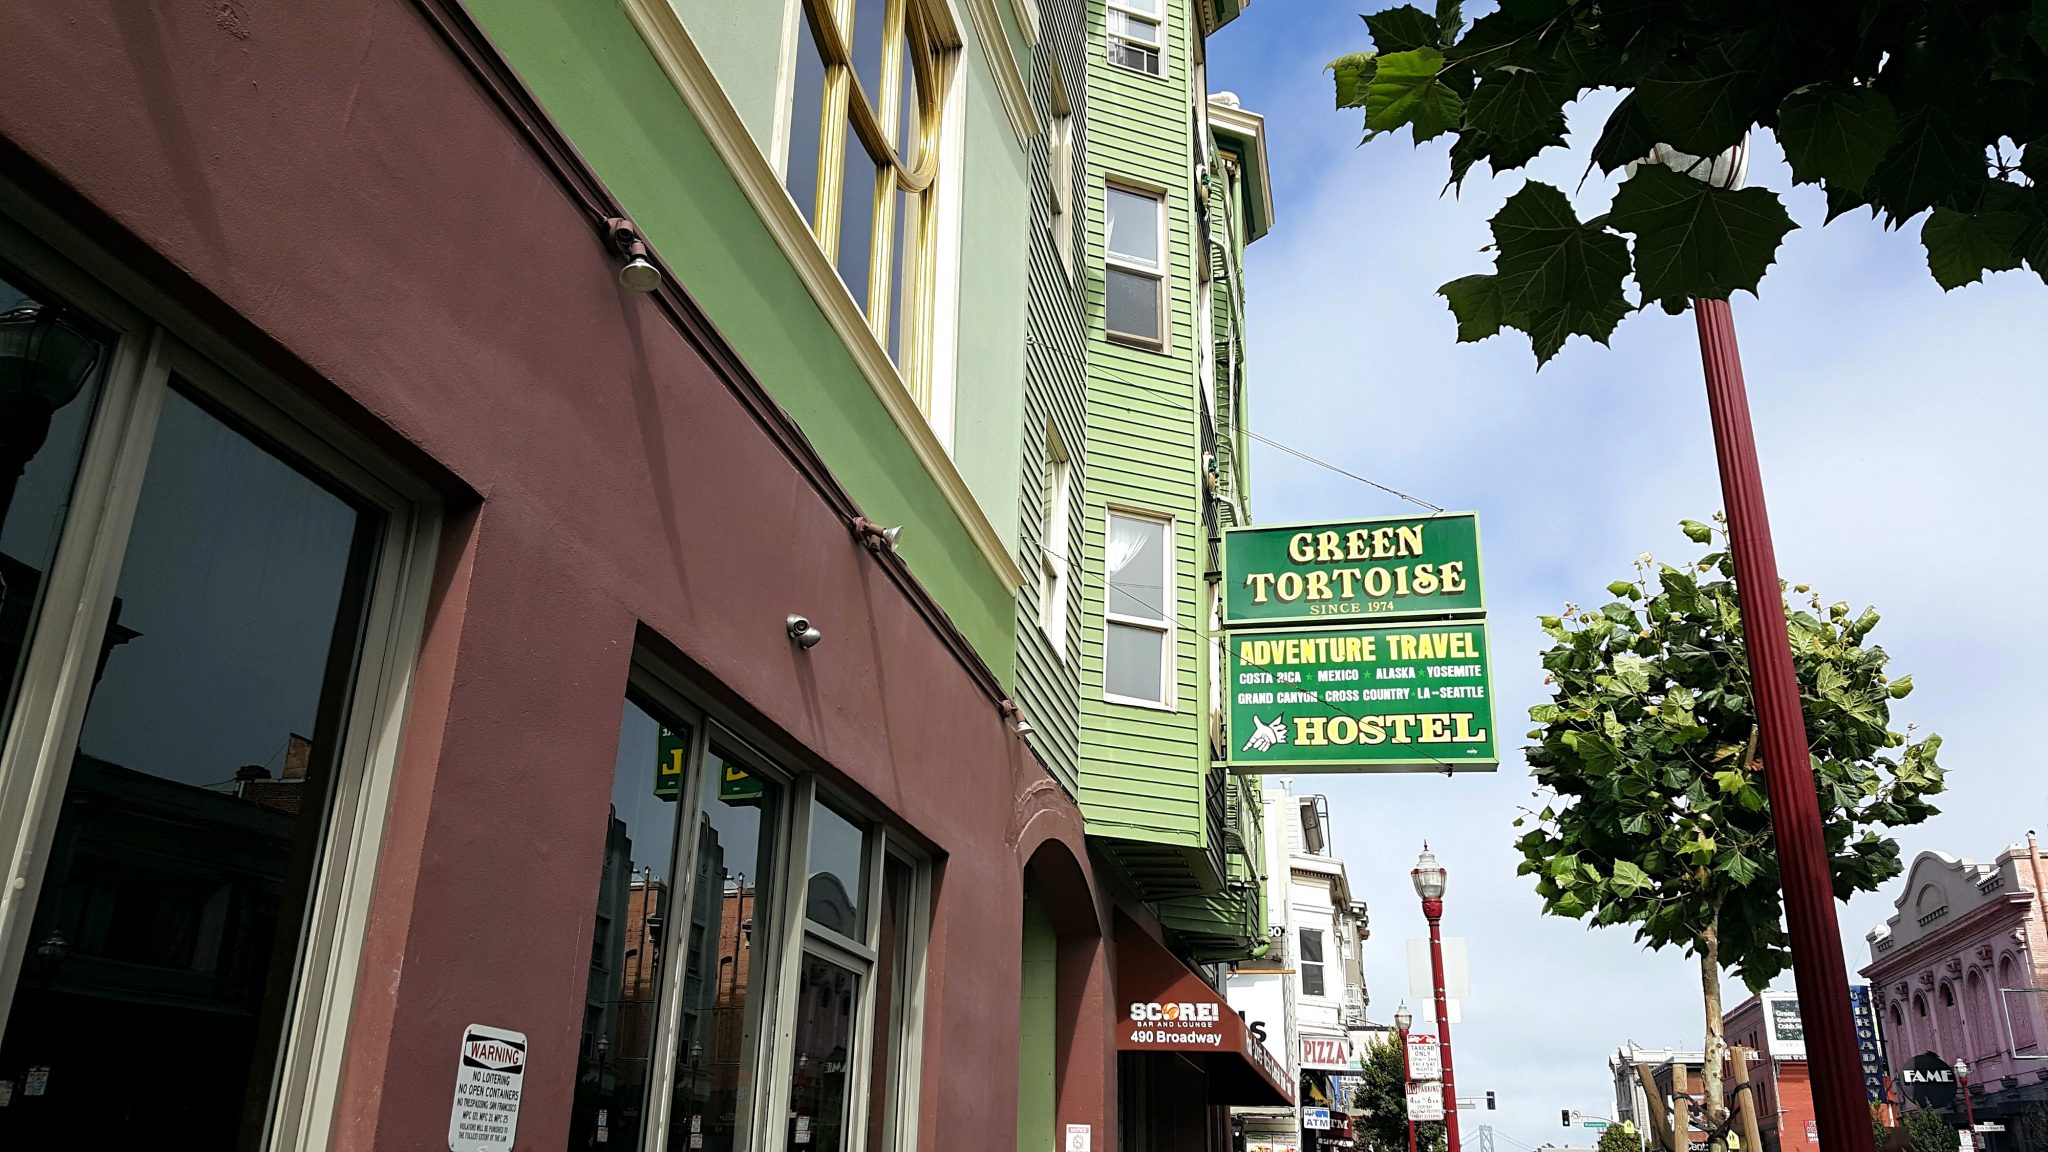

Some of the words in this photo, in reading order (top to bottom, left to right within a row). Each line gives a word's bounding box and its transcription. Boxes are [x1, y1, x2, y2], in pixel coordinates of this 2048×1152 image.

[1288, 524, 1423, 563] GREEN
[1246, 560, 1466, 602] TORTOISE
[1310, 603, 1360, 615] SINCE
[1368, 602, 1394, 612] 1974
[1240, 636, 1376, 666] ADVENTURE
[1386, 632, 1479, 660] TRAVEL
[1239, 672, 1273, 684] COSTA
[1277, 671, 1301, 683] RICA
[1317, 669, 1359, 682] MEXICO
[1376, 667, 1415, 679] ALASKA
[1427, 665, 1482, 678] YOSEMITE
[1238, 692, 1273, 704] GRAND
[1277, 691, 1318, 703] CANYON
[1325, 690, 1359, 702] CROSS
[1363, 688, 1410, 700] COUNTRY
[1293, 712, 1486, 746] HOSTEL
[1130, 1002, 1219, 1021] SCORE!
[1130, 1031, 1153, 1043] 490
[1156, 1031, 1222, 1046] Broadway
[471, 1041, 520, 1065] WARNING
[1303, 1040, 1347, 1065] PIZZA
[1854, 1006, 1881, 1099] BROADWAY
[473, 1070, 481, 1082] NO
[482, 1072, 511, 1086] LOITERING
[1903, 1070, 1954, 1083] FAME
[458, 1083, 468, 1094] NO
[469, 1085, 485, 1097] OPEN
[485, 1087, 519, 1101] CONTAINERS
[1418, 1085, 1440, 1093] PARKING
[457, 1098, 463, 1106] NO
[464, 1098, 489, 1109] TRESPASSING
[489, 1101, 497, 1110] SAN
[497, 1103, 517, 1112] FRANCISCO
[1306, 1119, 1329, 1127] ATM
[1330, 1119, 1349, 1129] TM
